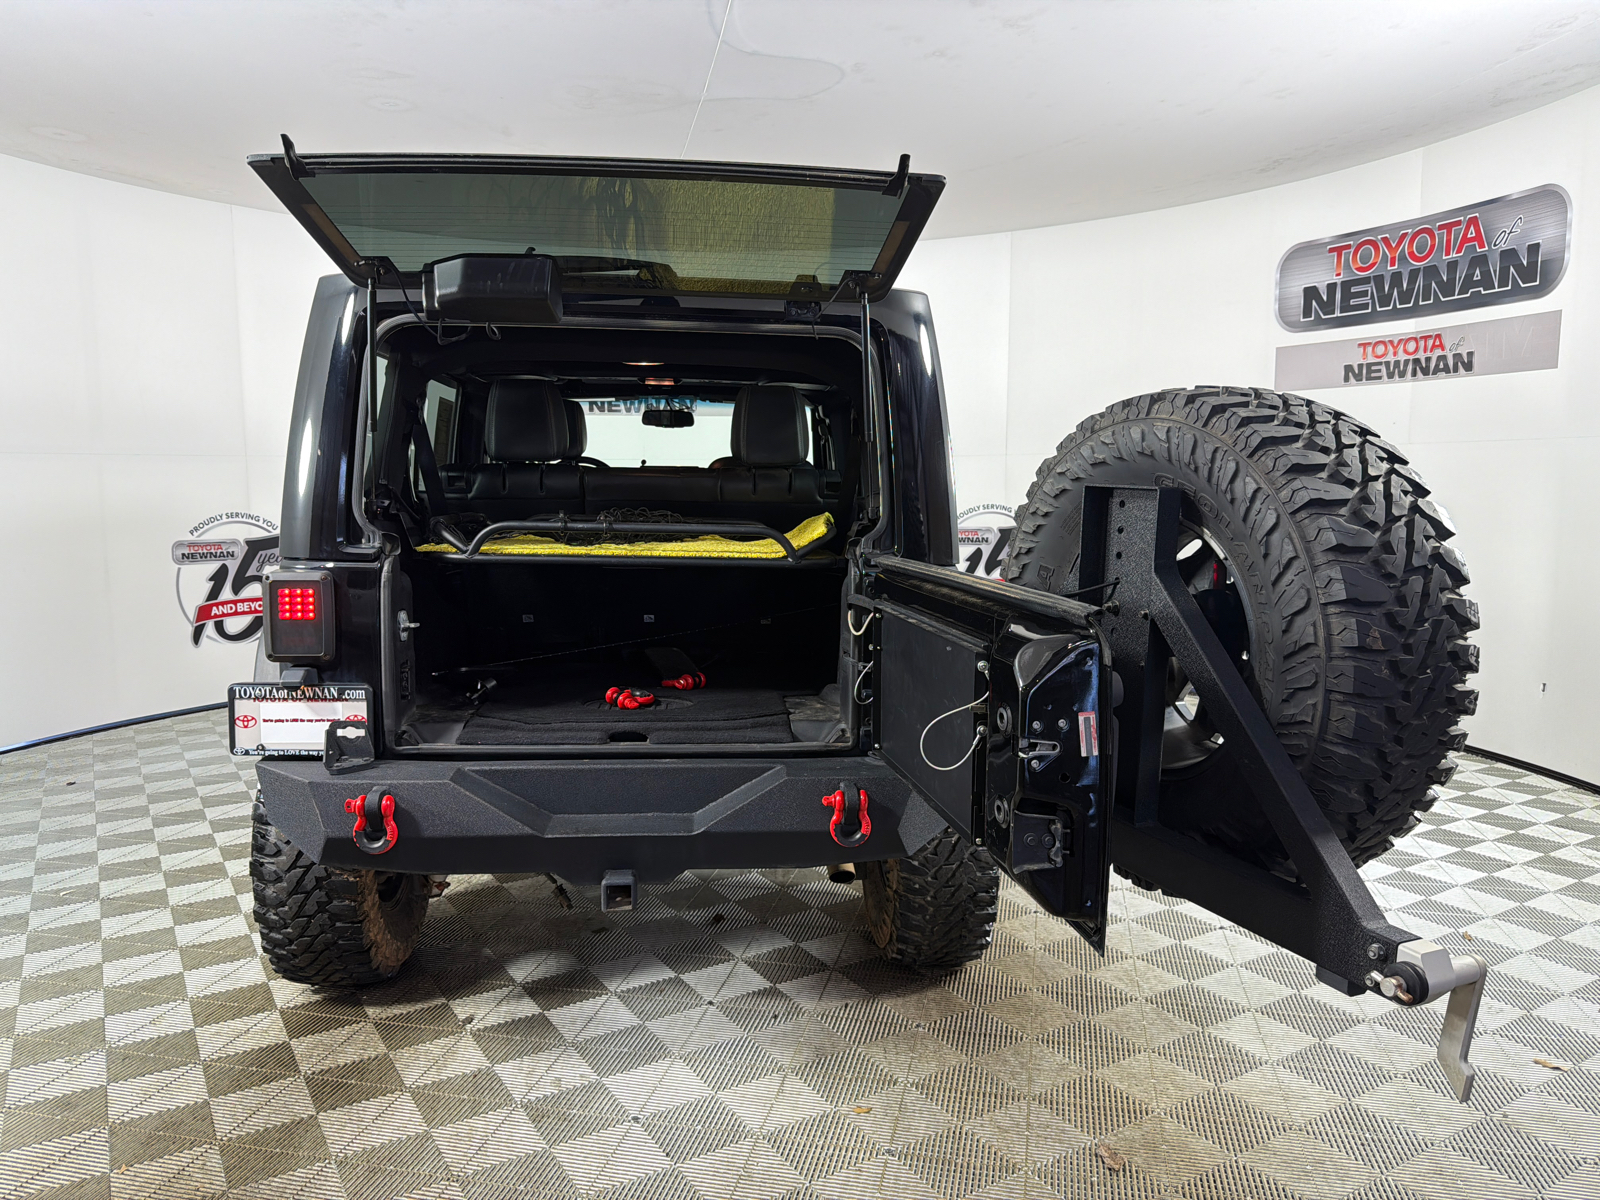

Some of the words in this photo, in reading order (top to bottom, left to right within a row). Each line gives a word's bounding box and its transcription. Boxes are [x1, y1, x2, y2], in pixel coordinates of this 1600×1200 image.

[1327, 213, 1488, 278] TOYOTA
[1493, 215, 1523, 249] of
[1300, 240, 1543, 321] NEWNAN
[1357, 332, 1446, 361] TOYOTA
[1448, 336, 1466, 353] of
[1343, 350, 1475, 384] NEWNAN
[957, 505, 981, 519] OUDLY
[982, 503, 1013, 513] SERVING
[189, 513, 224, 536] PROUDLY
[225, 512, 261, 522] SERVING
[261, 518, 279, 531] YOU
[181, 550, 235, 560] NEWNAN
[186, 544, 223, 552] TOYOTA
[211, 603, 236, 616] AND
[237, 601, 263, 612] BEYO
